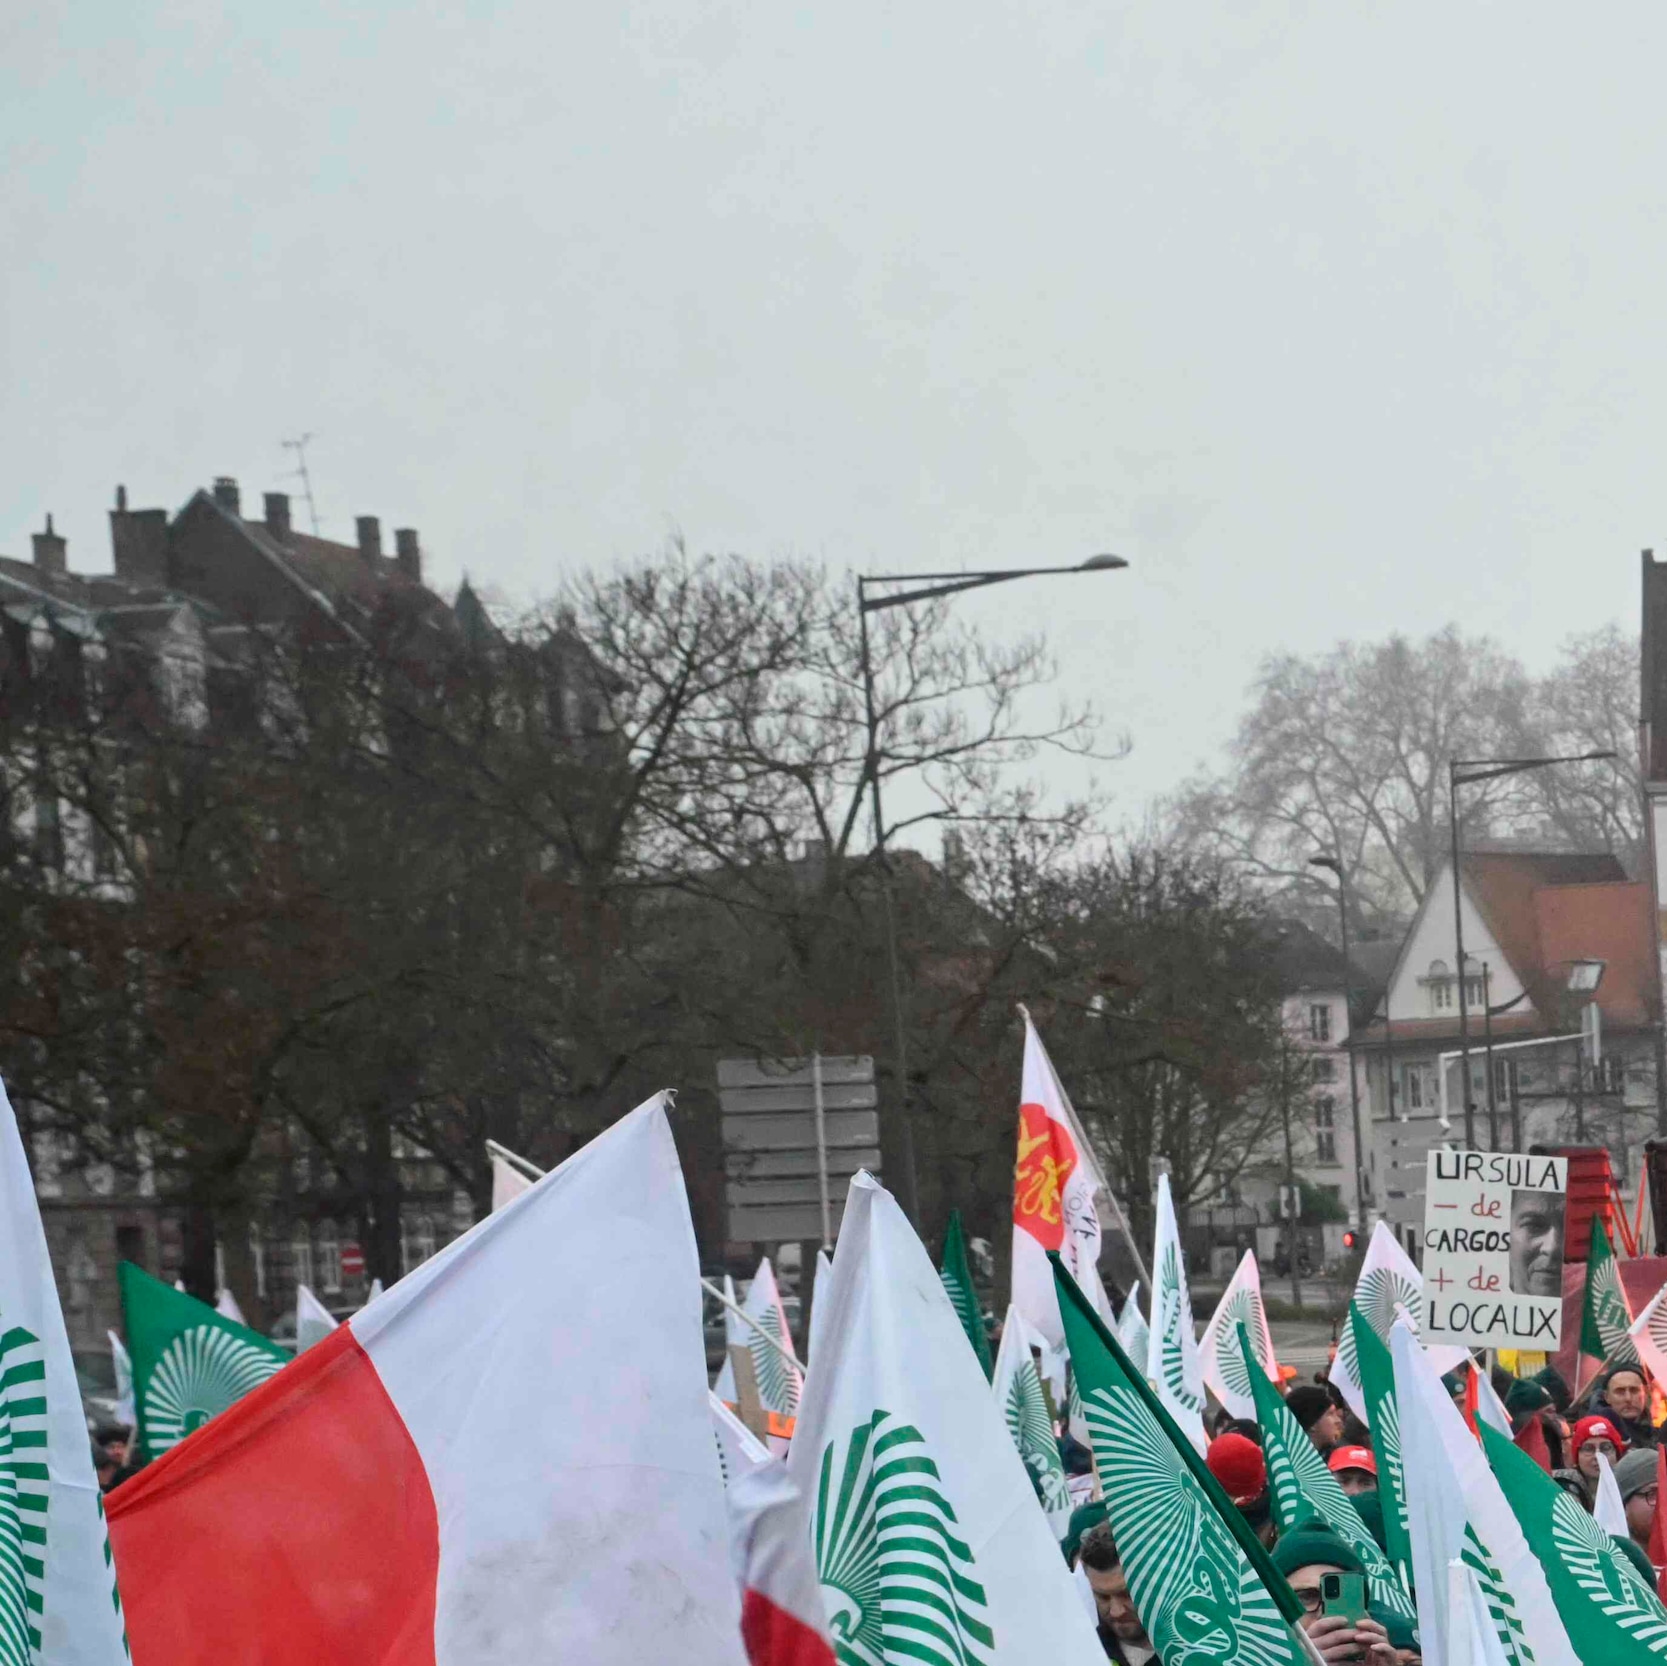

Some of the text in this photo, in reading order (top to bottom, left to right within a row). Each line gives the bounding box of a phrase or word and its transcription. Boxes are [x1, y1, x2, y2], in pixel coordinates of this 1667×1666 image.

[1436, 1152, 1560, 1190] URSULA
[1471, 1193, 1502, 1218] de
[1426, 1228, 1511, 1252] CARGOS
[1468, 1265, 1500, 1292] de
[1429, 1301, 1557, 1340] LOCAUX
